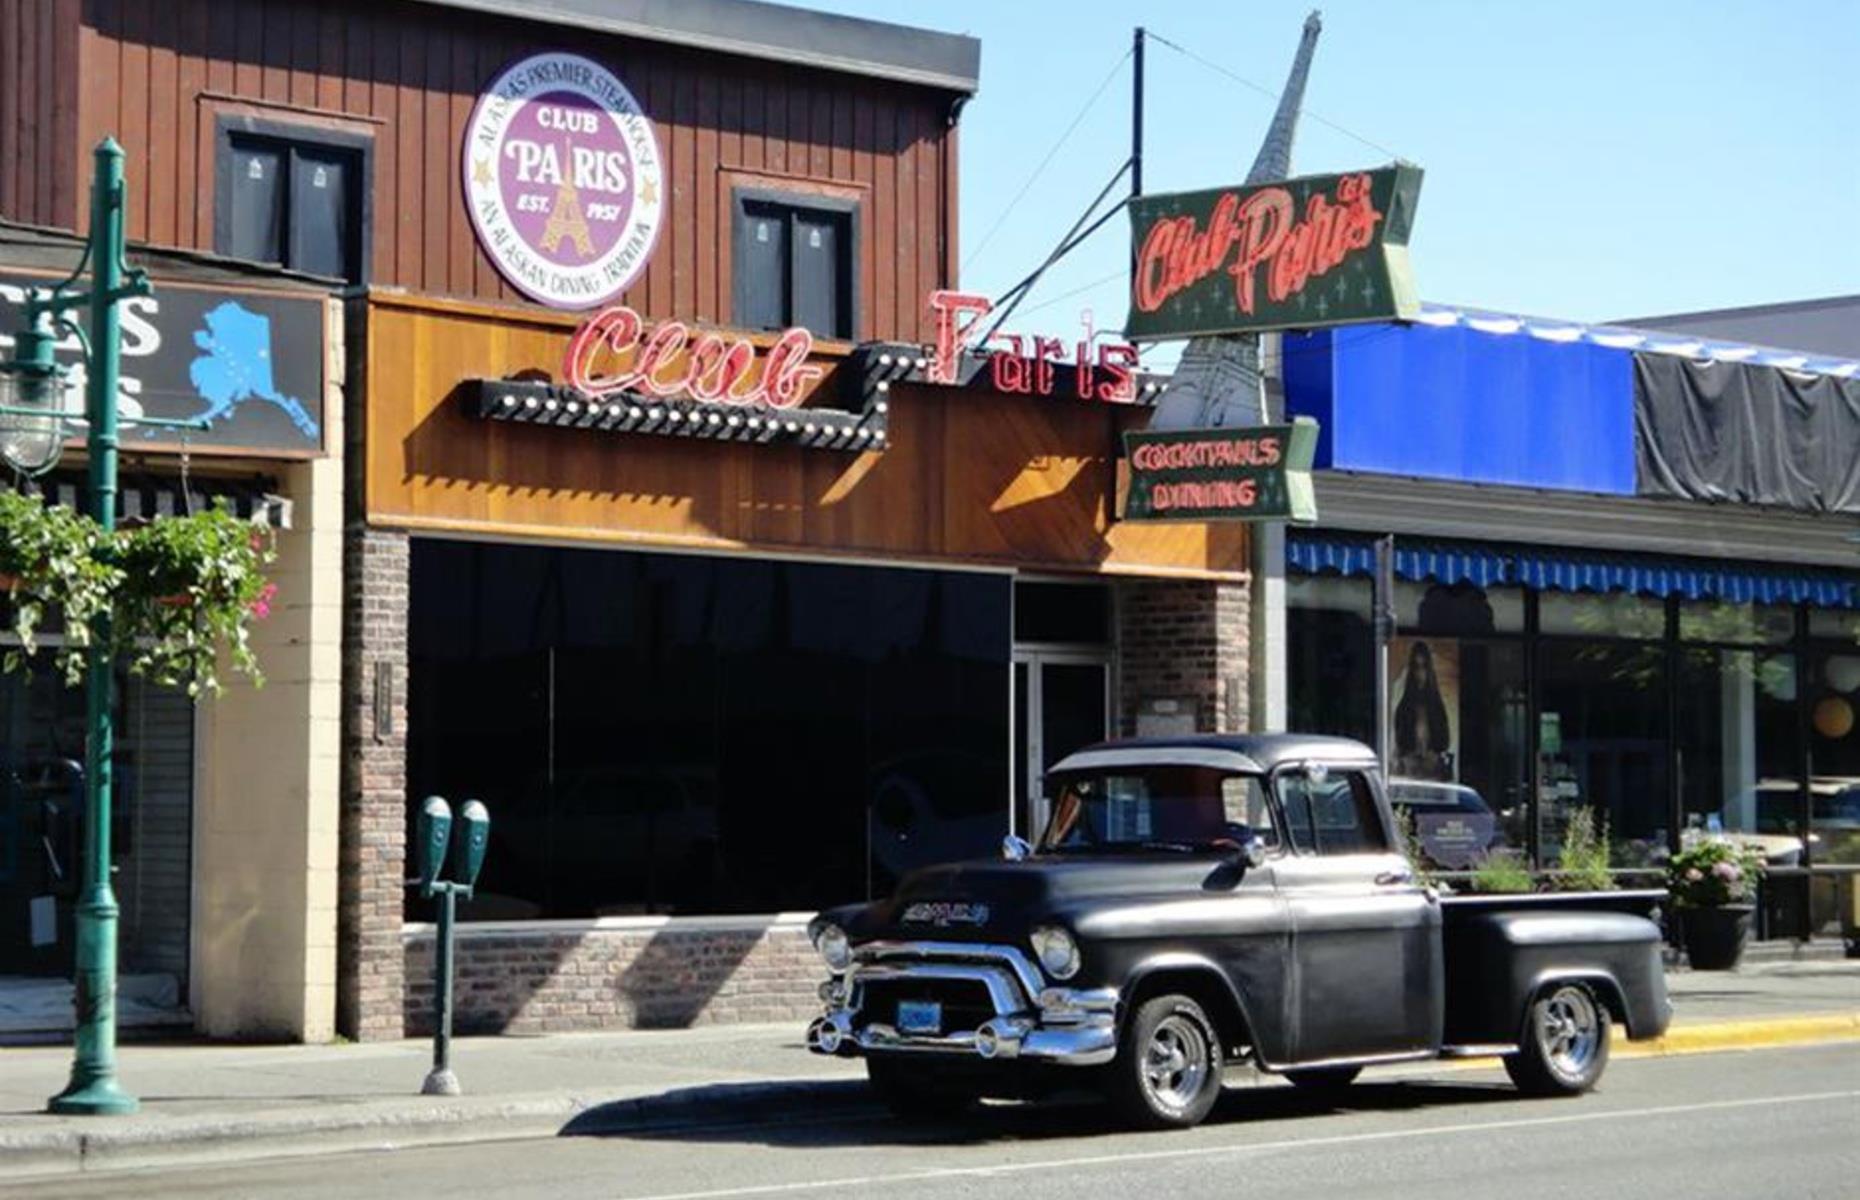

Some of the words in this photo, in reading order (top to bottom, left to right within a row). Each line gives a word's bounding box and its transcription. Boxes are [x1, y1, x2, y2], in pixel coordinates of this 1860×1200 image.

[527, 61, 593, 88] PREMIER
[537, 107, 599, 134] CLUB
[504, 139, 627, 195] PARIS
[516, 193, 550, 213] EST.
[480, 200, 500, 225] AN
[493, 227, 547, 288] ALASKAN
[551, 273, 601, 295] DINING
[602, 221, 652, 284] TRADITION
[1135, 192, 1241, 313] Club
[563, 306, 824, 409] Club
[928, 289, 1139, 404] Paris
[1132, 437, 1282, 470] COCKTAILS
[1151, 479, 1257, 510] DINING
